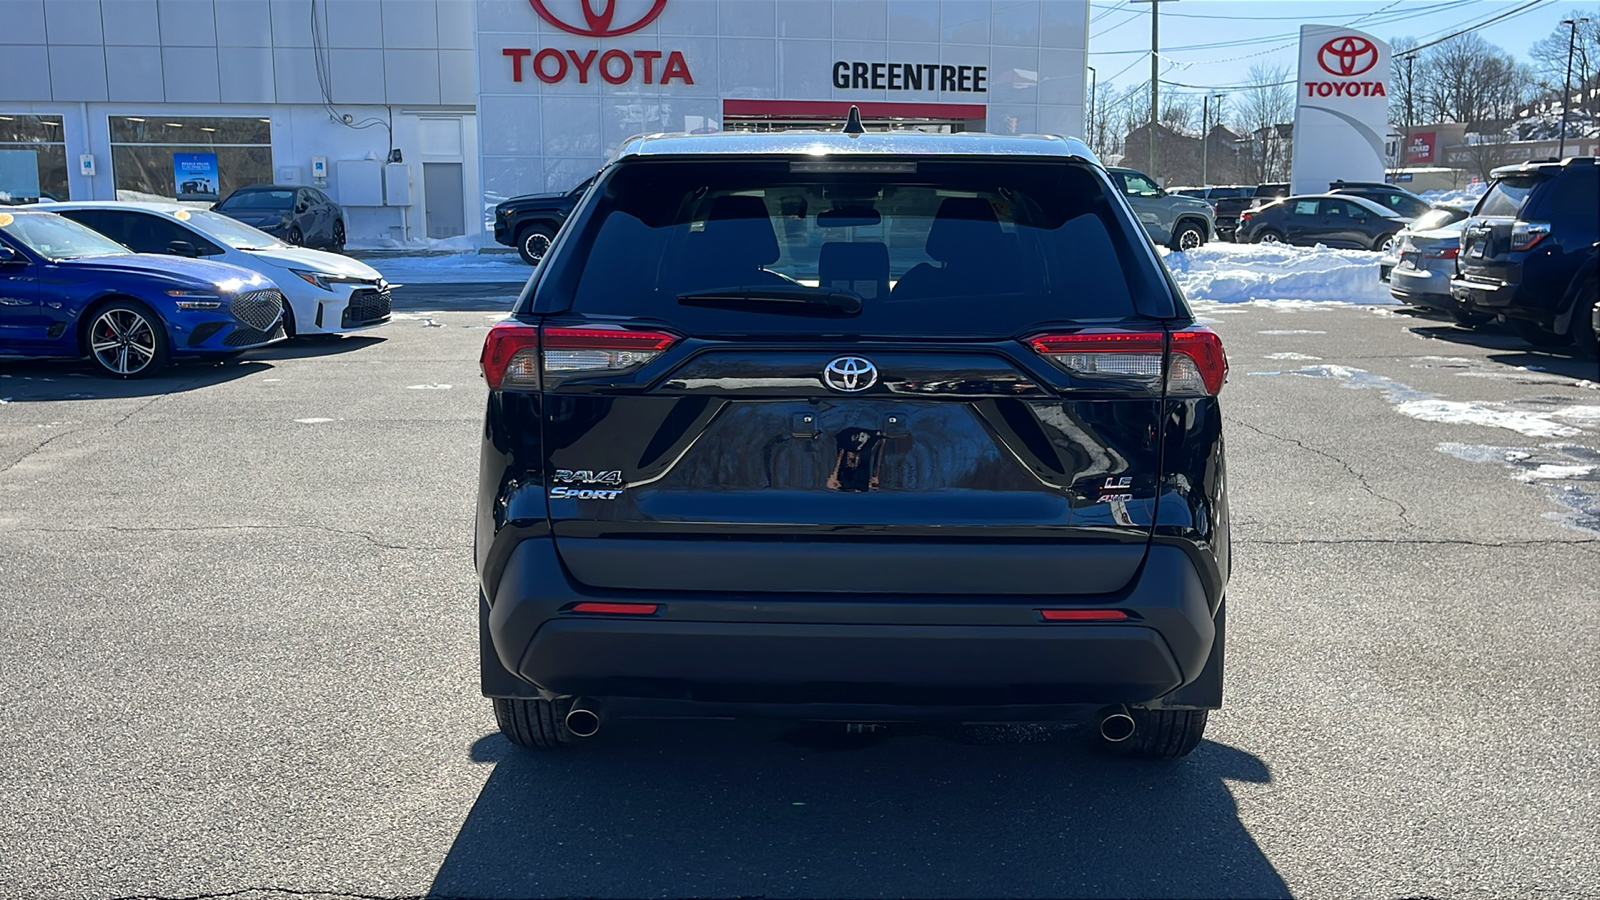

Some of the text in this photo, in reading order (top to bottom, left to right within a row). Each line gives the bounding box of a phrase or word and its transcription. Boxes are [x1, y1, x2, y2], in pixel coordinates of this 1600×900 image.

[502, 47, 695, 85] TOYOTA
[832, 61, 987, 92] GREENTREE
[1304, 81, 1386, 97] TOYOTA
[553, 469, 622, 485] RAV4
[1104, 476, 1133, 488] LE
[549, 486, 623, 499] SPORT
[1096, 493, 1133, 503] AWD
